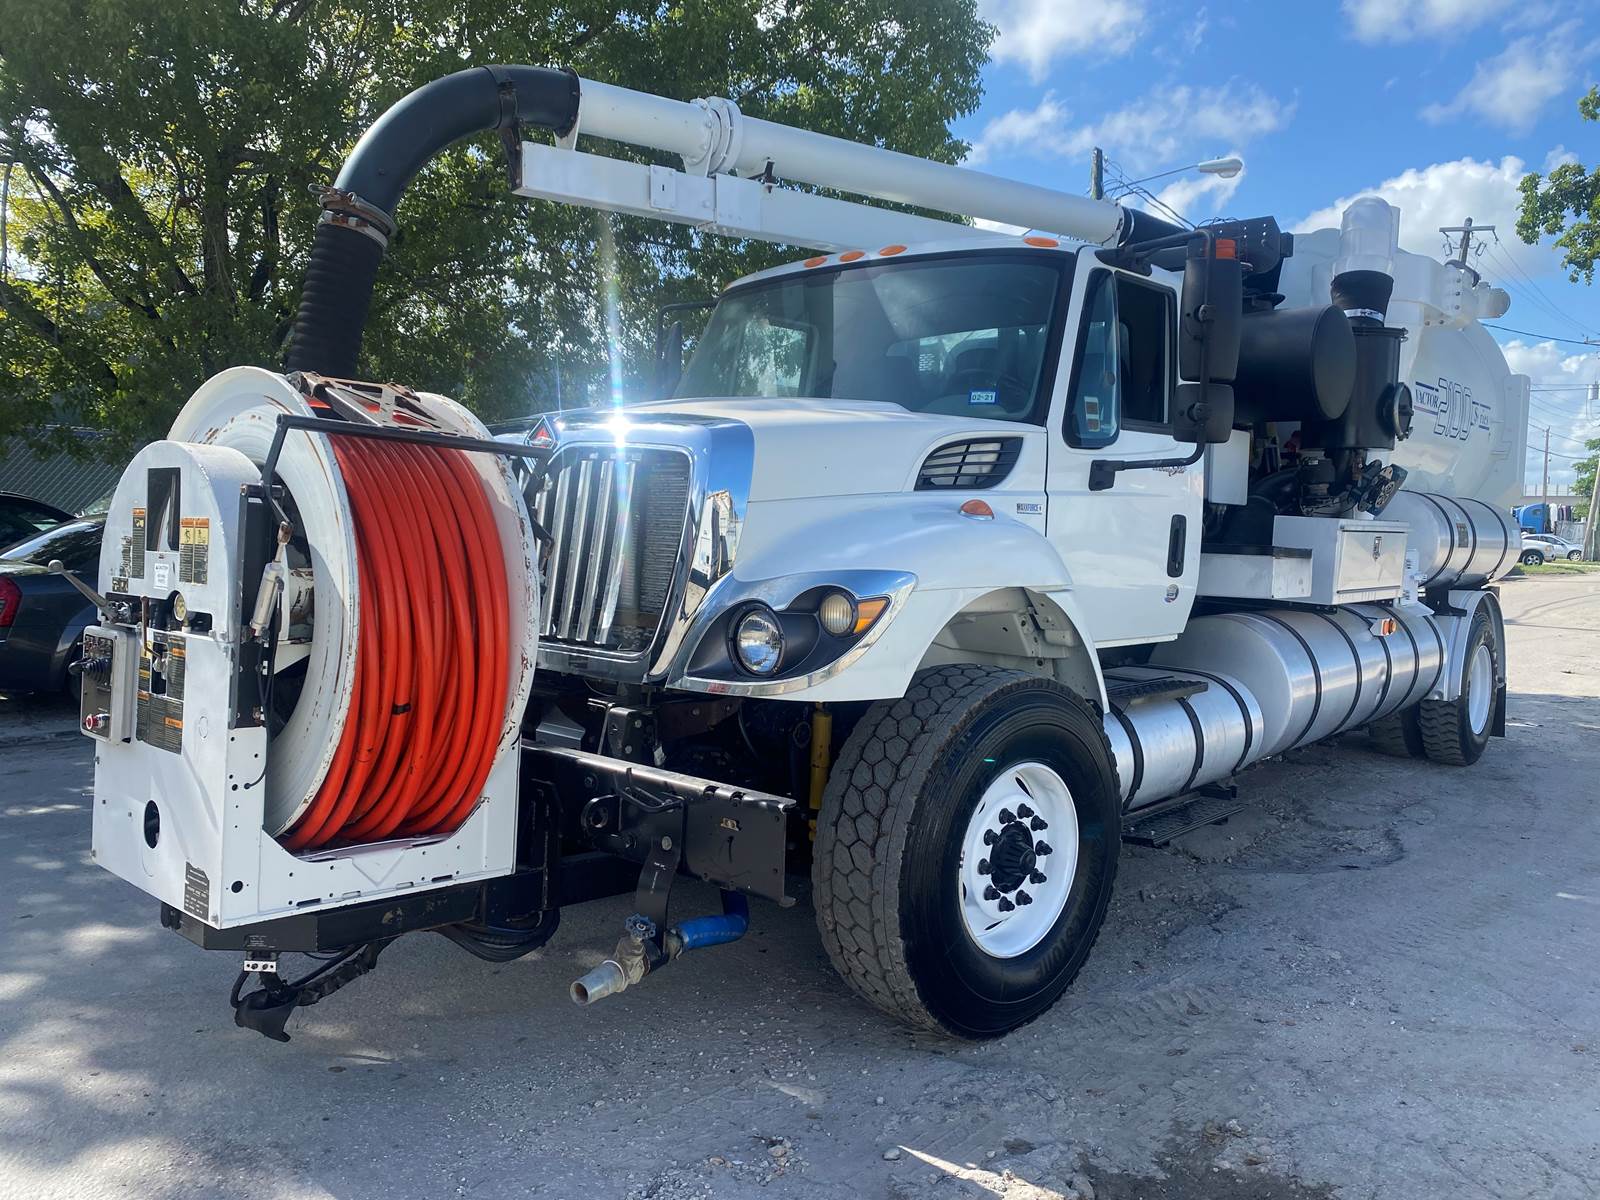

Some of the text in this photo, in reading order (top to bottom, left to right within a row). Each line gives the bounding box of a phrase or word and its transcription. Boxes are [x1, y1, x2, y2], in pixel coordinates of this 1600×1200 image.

[1415, 377, 1489, 440] VACTOR 2100 Sries
